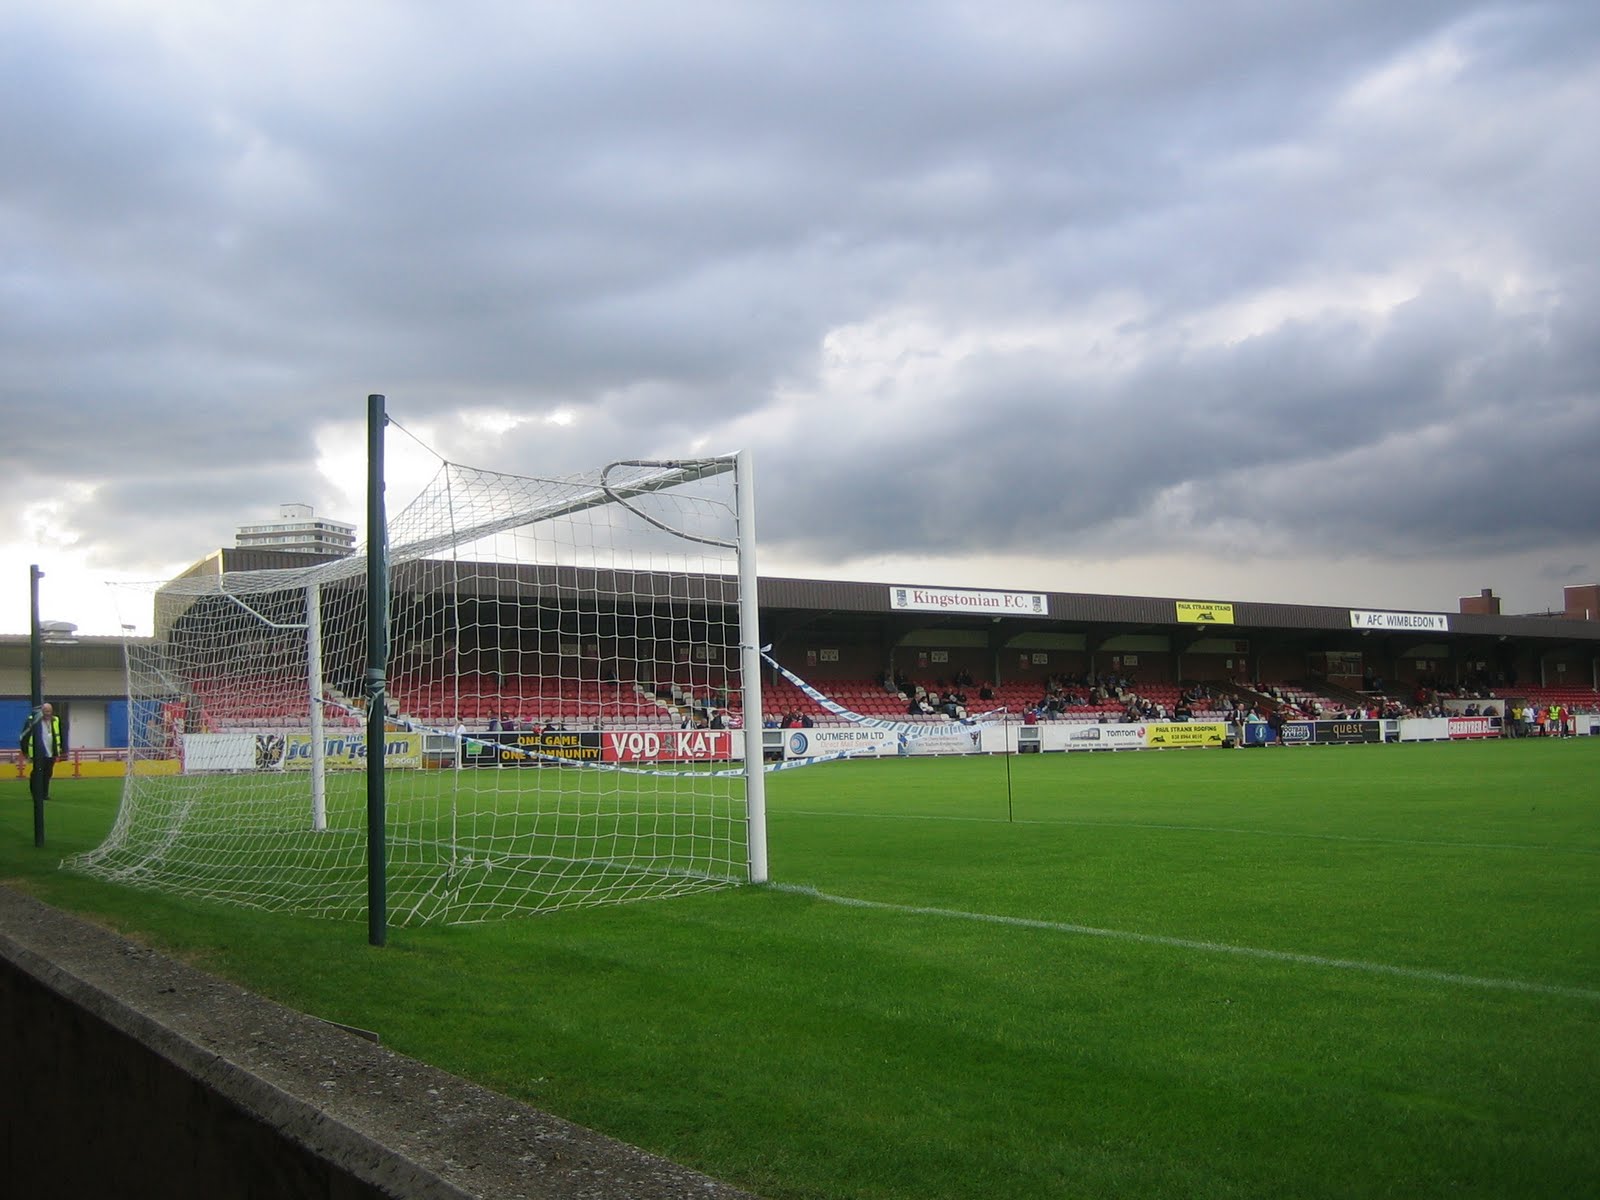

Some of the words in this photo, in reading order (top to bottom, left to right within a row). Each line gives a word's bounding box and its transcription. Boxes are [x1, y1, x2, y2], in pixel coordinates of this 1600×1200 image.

[913, 590, 1000, 607] Kingstonian
[1004, 595, 1028, 608] F.C.
[1367, 614, 1382, 625] AFC
[1386, 615, 1434, 628] WIMBLEDON
[815, 732, 854, 741] OUTMERE
[856, 732, 868, 740] DM
[870, 731, 884, 740] LTD
[1333, 723, 1363, 739] quest
[518, 736, 541, 746] ONE
[677, 732, 721, 757] KAT
[345, 740, 409, 759] Tem
[501, 750, 526, 760] ONE
